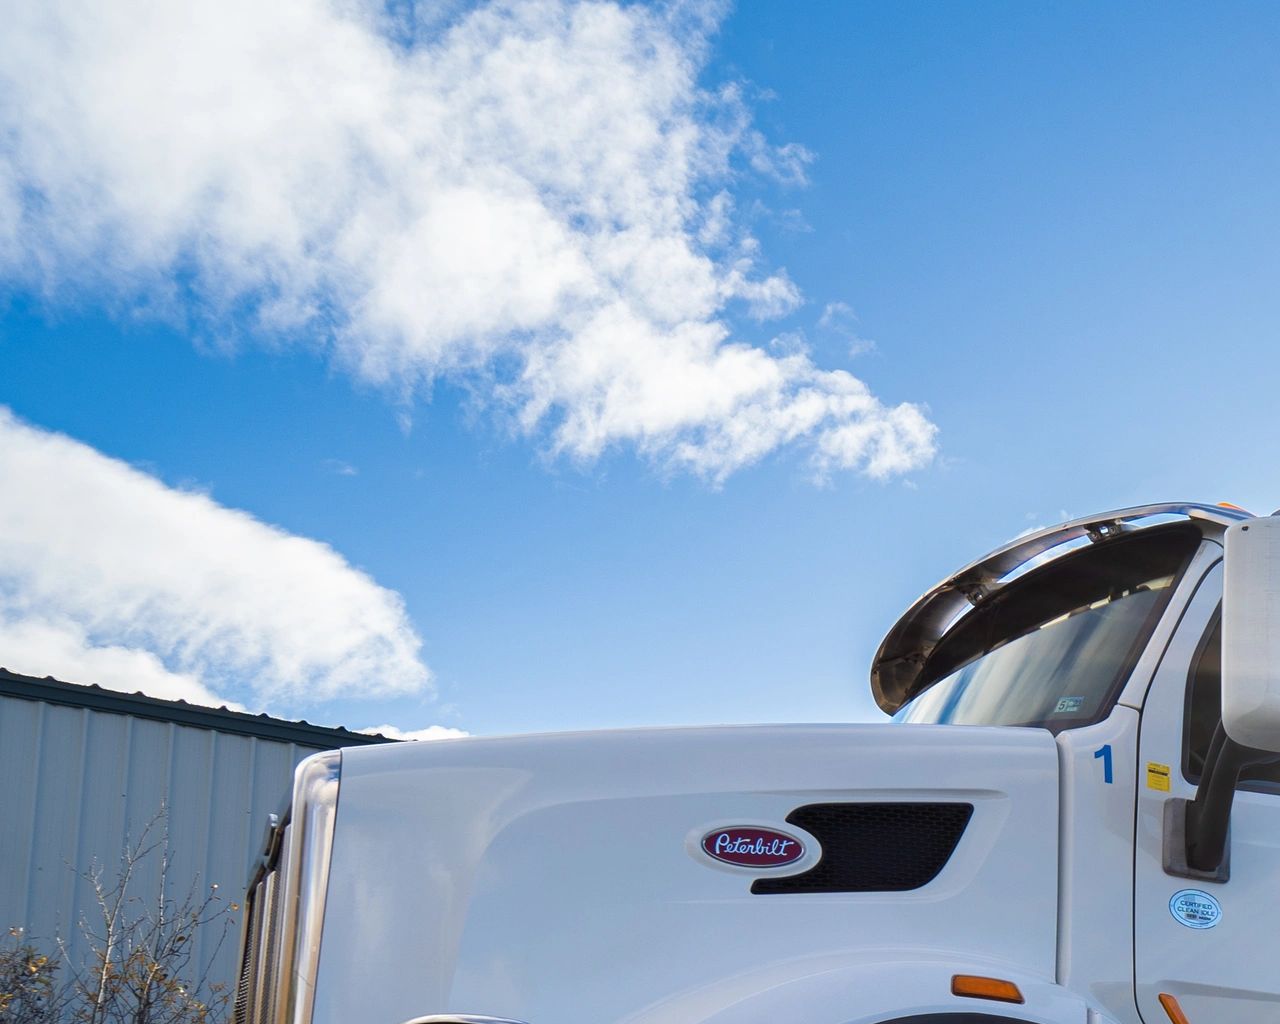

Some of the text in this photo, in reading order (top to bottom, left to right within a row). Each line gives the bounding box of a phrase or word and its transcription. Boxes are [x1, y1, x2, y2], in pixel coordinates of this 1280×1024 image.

[1093, 744, 1113, 784] 1
[715, 833, 795, 856] Peterbilt
[1177, 906, 1199, 914] CLEAN
[1180, 900, 1213, 910] CERTIFIED
